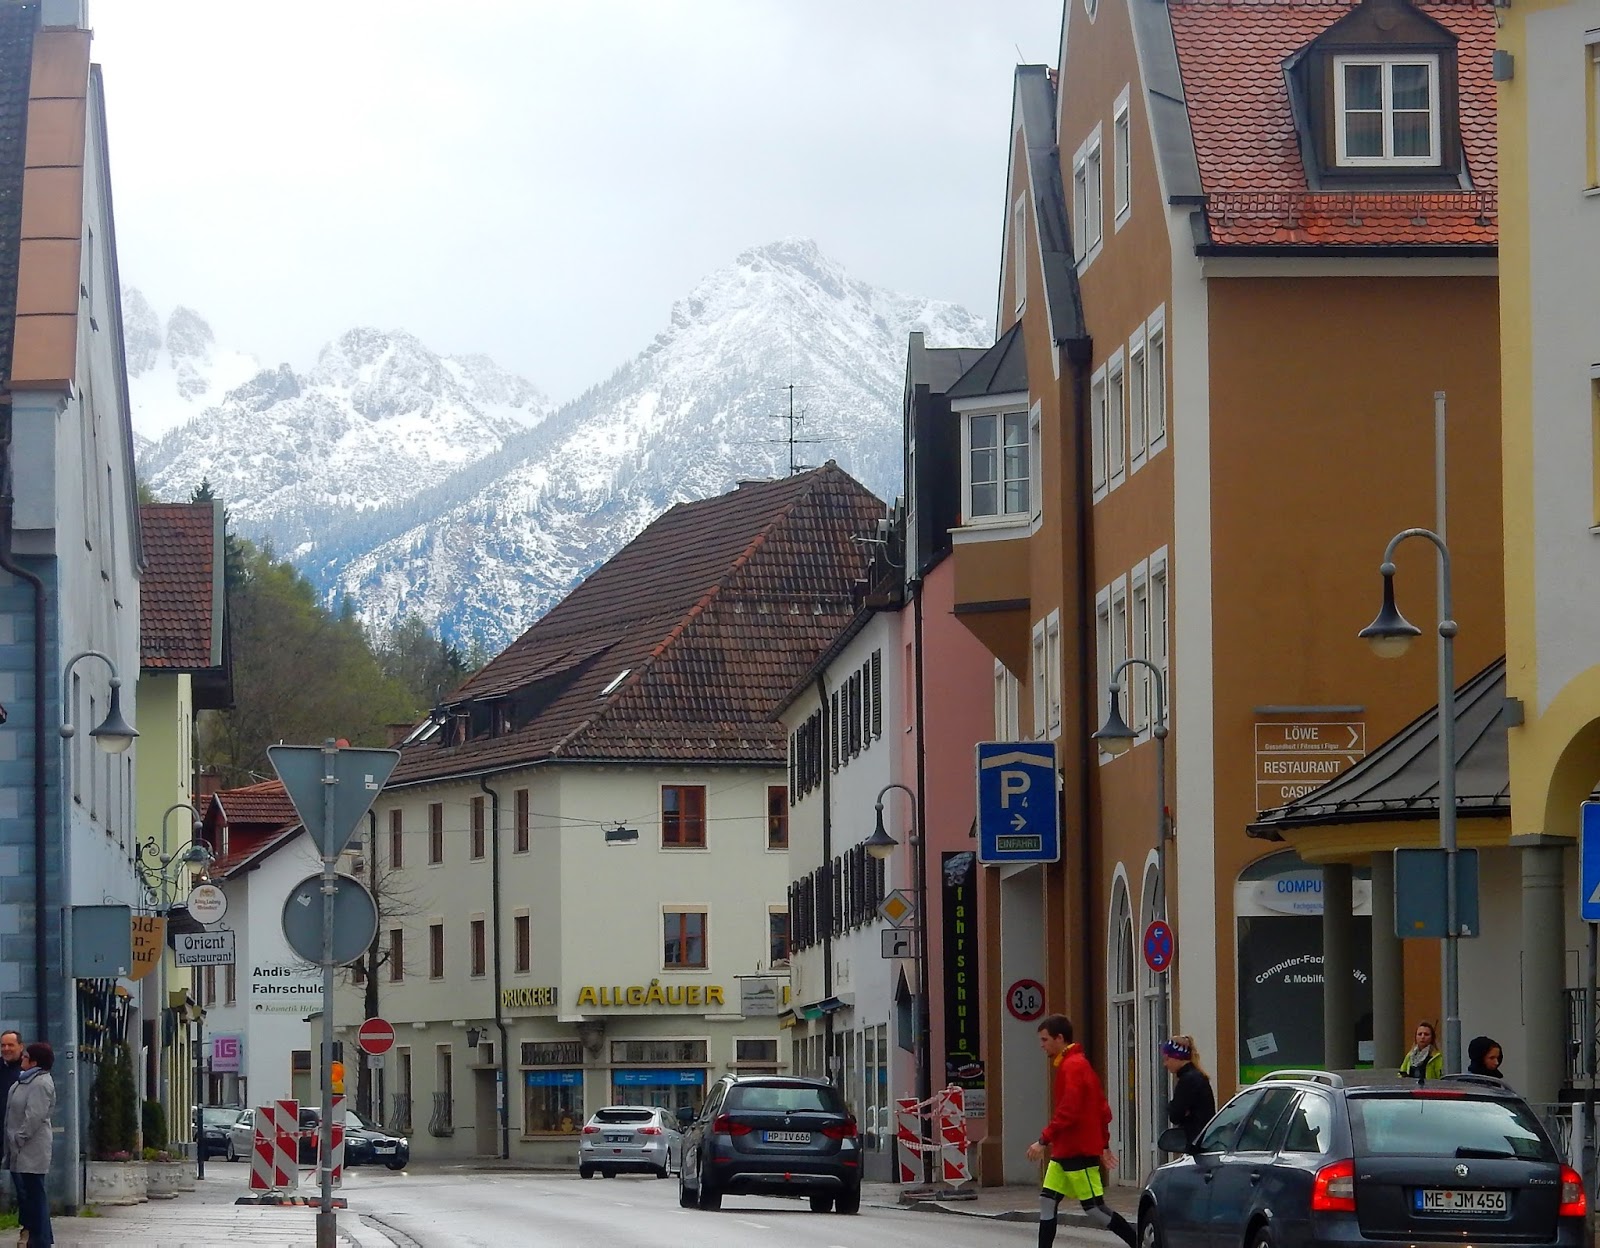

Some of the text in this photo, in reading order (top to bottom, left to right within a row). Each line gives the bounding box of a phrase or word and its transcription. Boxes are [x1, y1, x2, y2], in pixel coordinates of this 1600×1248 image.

[1284, 725, 1319, 740] LÖWE
[1324, 742, 1339, 751] Figur
[1263, 760, 1341, 774] RESTAURANT
[1000, 770, 1031, 809] P
[1280, 785, 1320, 799] CASIN
[998, 839, 1038, 849] EINFAHRT
[184, 935, 226, 950] Orient
[178, 951, 233, 964] Restaurant
[956, 886, 967, 1050] fahrschule
[1284, 975, 1292, 983] &
[252, 983, 325, 994] Fahrschule
[576, 978, 726, 1006] ALLGÄUER
[501, 987, 557, 1008] DRUCKEREI
[767, 1132, 810, 1141] HP IV 666
[1425, 1193, 1444, 1207] ME
[1455, 1193, 1474, 1208] JM
[1477, 1194, 1504, 1208] 456
